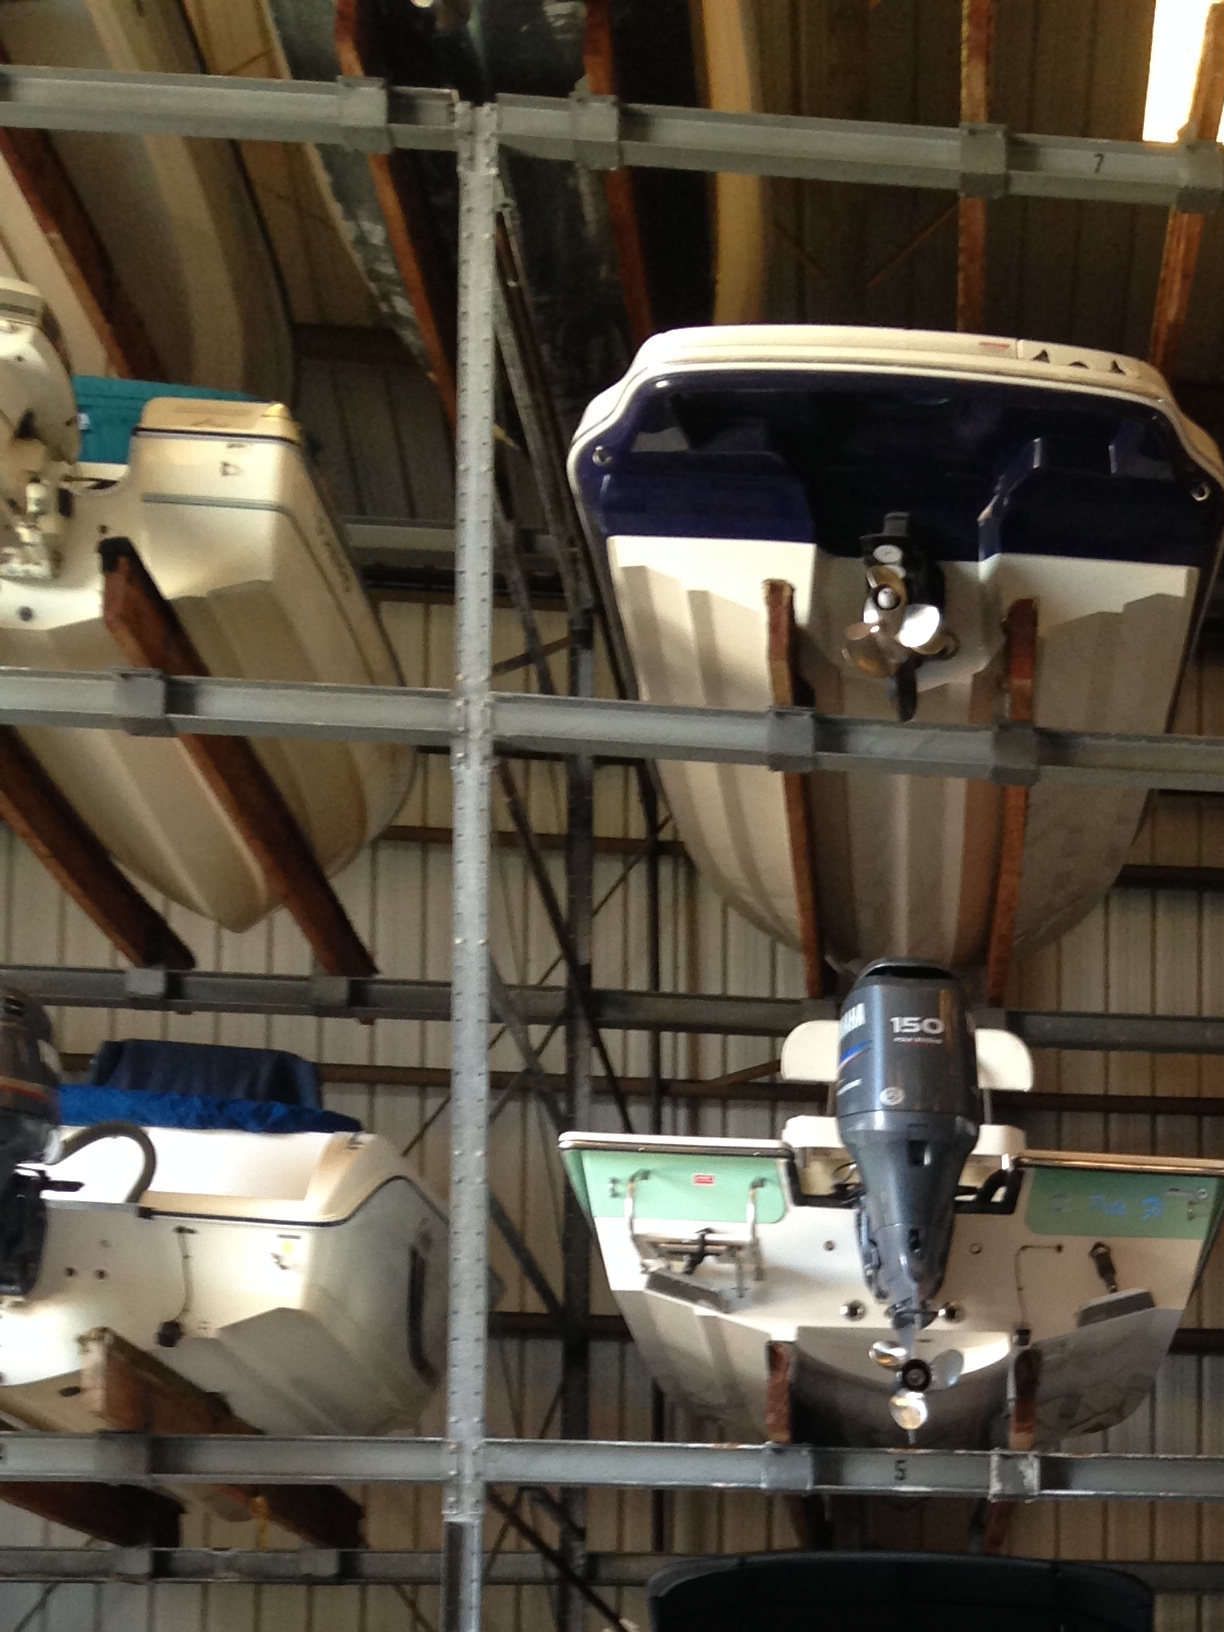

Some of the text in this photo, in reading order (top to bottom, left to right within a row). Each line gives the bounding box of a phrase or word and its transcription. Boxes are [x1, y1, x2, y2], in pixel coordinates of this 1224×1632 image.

[1093, 152, 1105, 174] 7
[889, 1016, 946, 1035] 150
[894, 1459, 907, 1481] 5
